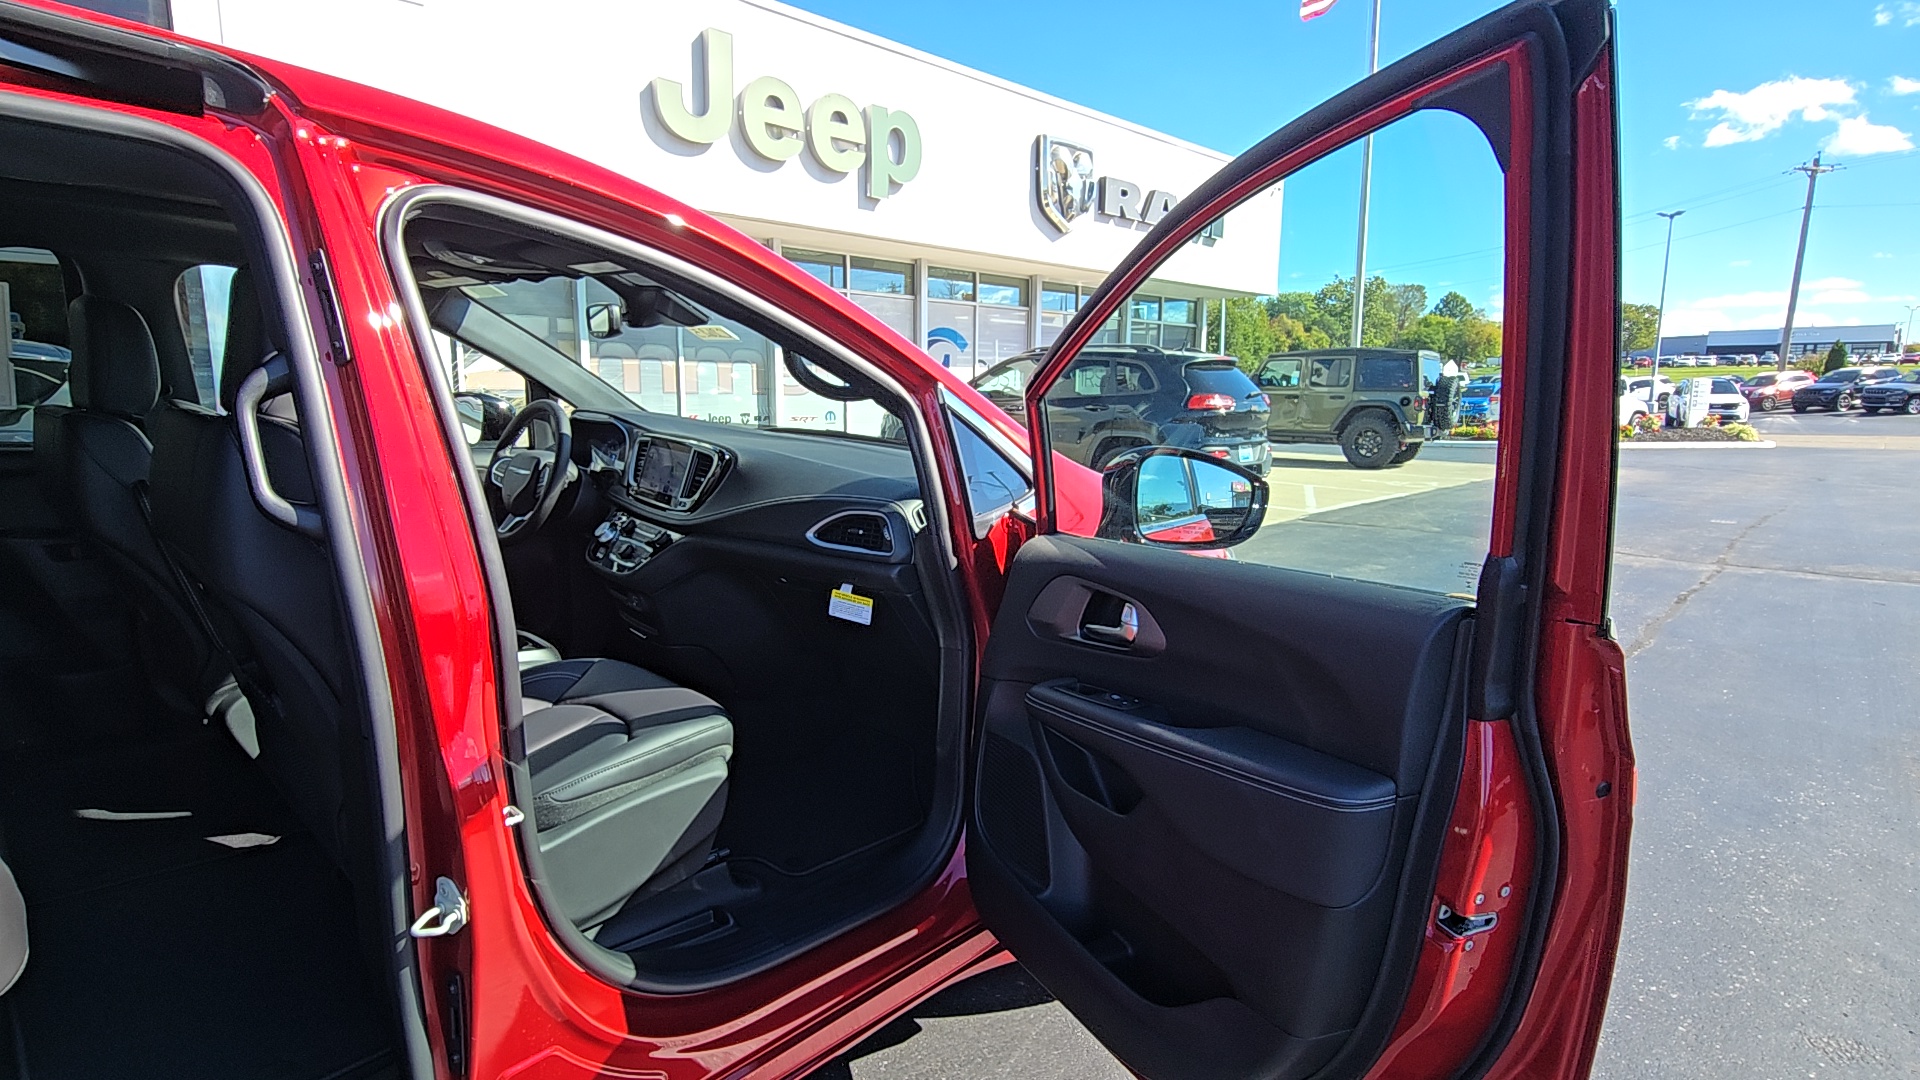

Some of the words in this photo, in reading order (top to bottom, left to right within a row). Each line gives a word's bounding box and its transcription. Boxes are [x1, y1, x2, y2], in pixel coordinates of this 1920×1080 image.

[649, 27, 922, 201] Jeep
[704, 412, 732, 425] Jeep
[789, 415, 819, 423] SRT
